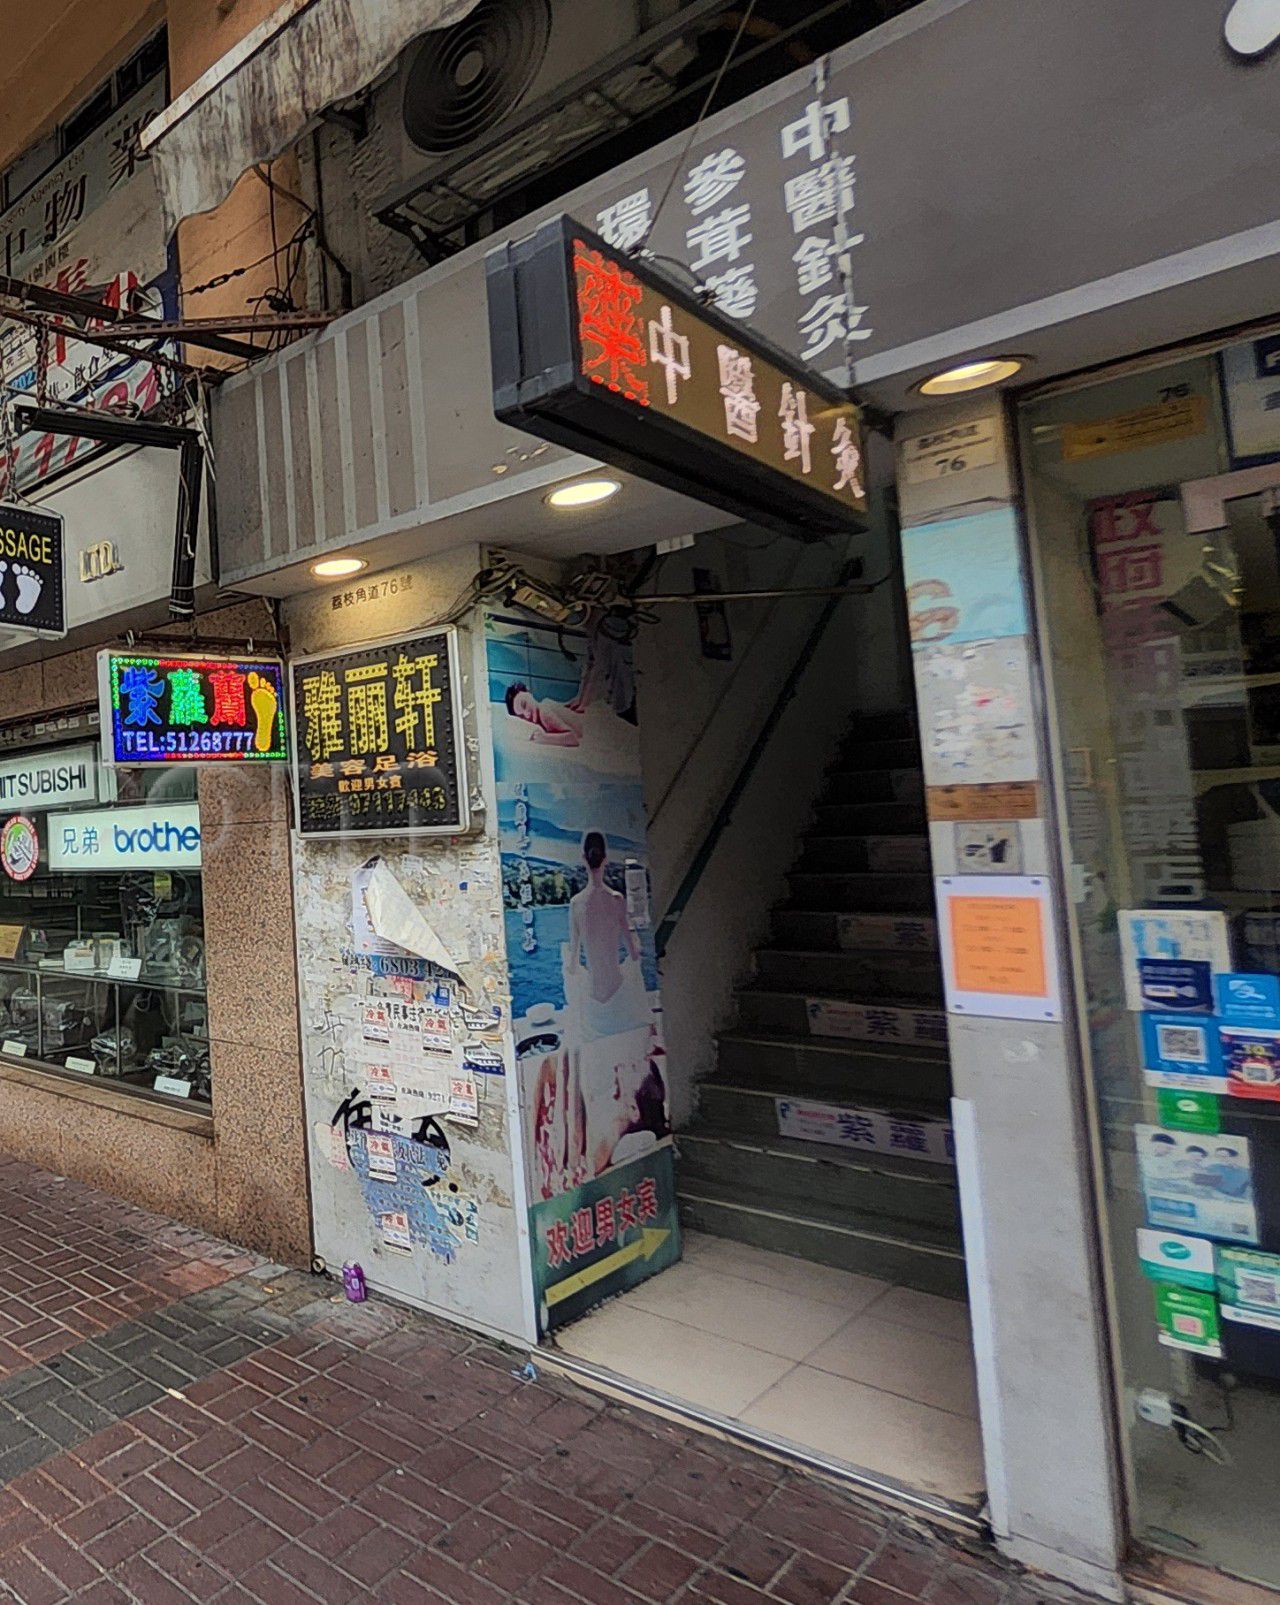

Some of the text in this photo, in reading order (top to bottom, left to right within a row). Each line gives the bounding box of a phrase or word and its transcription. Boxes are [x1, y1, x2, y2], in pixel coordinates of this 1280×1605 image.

[780, 97, 874, 361] 中醫針灸
[647, 304, 867, 498] 中醫針灸
[934, 454, 967, 475] 76
[122, 729, 254, 752] TEL:51268777
[309, 750, 439, 781] 美容足浴
[61, 826, 100, 856] 兄弟
[425, 1017, 447, 1031] 冷氣
[545, 1177, 658, 1269] 欢迎男女宾
